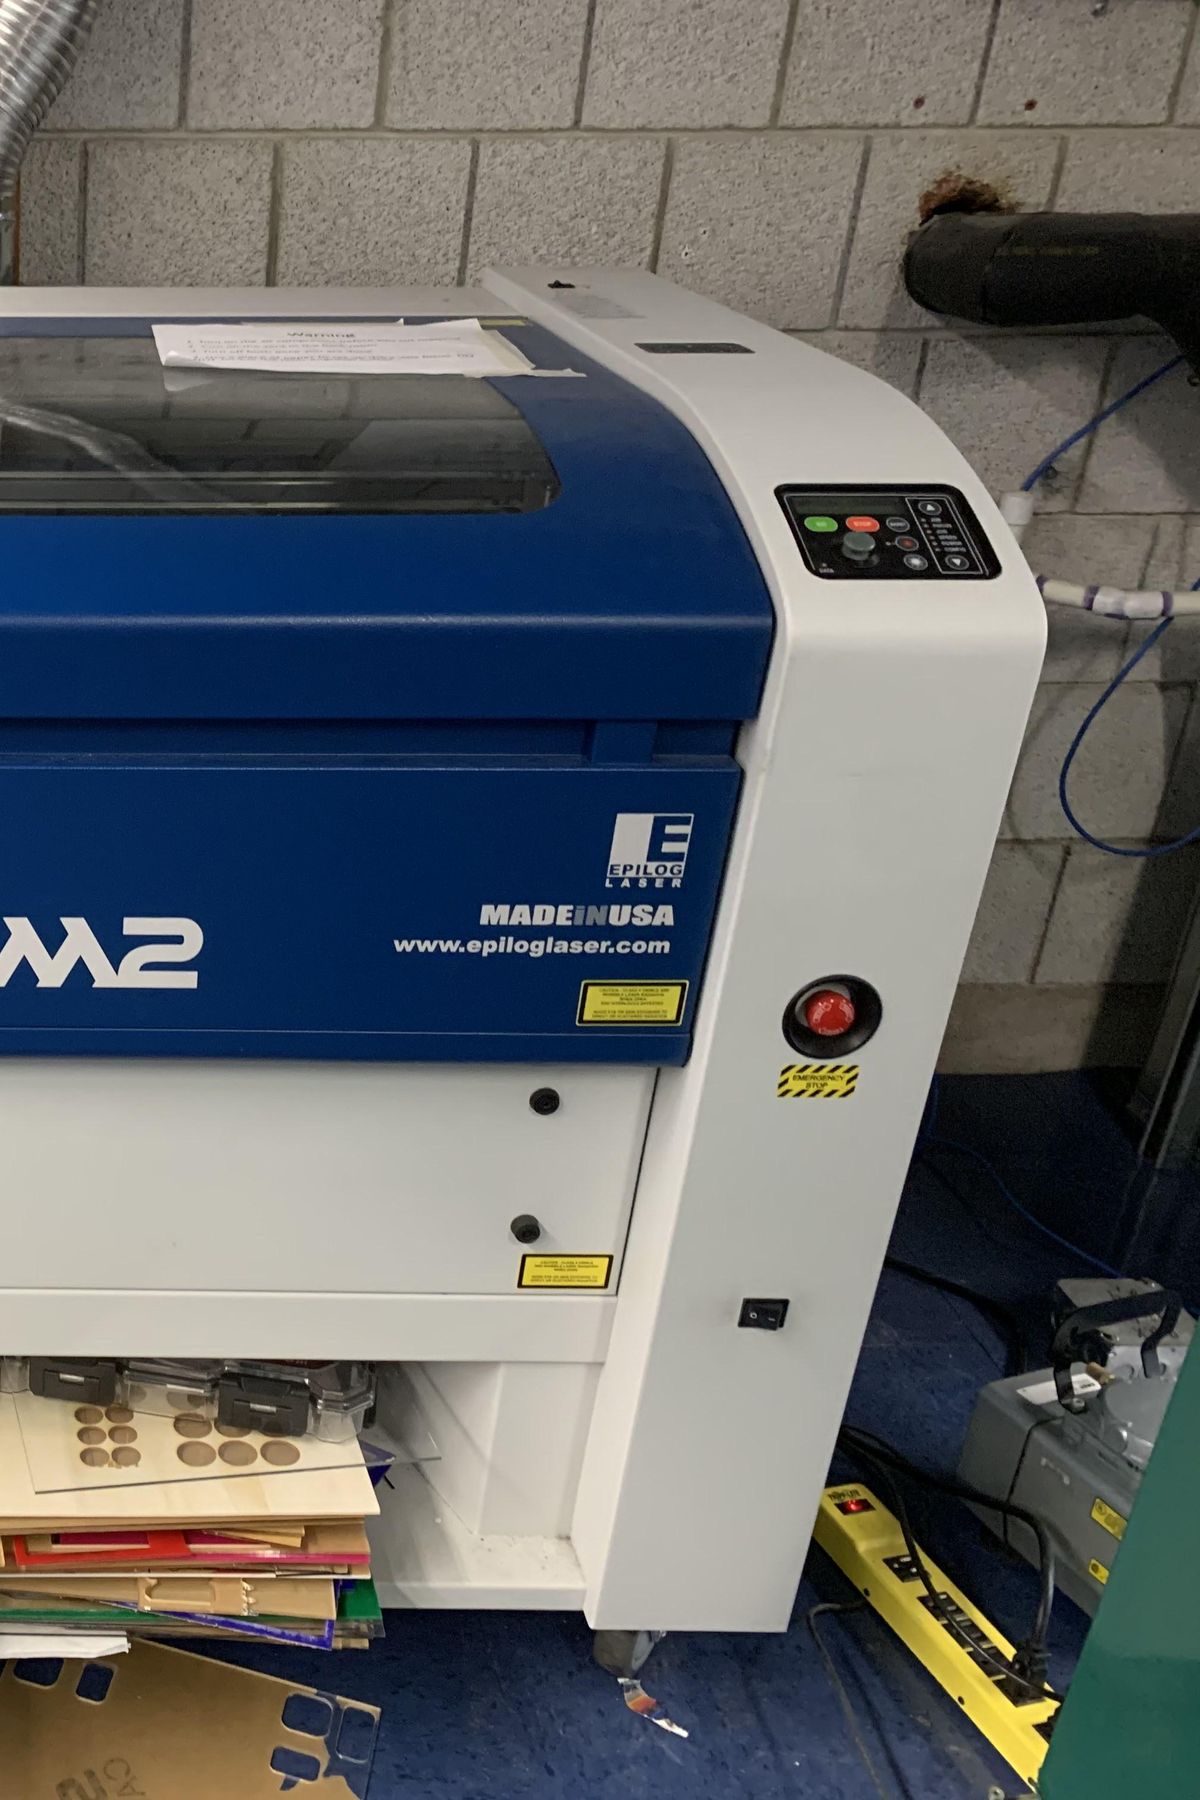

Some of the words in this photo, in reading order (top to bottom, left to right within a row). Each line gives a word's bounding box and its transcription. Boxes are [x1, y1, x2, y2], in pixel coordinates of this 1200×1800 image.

[609, 863, 683, 876] EPILOG
[605, 877, 682, 888] LASER
[393, 936, 671, 958] www.epiloglaser.com
